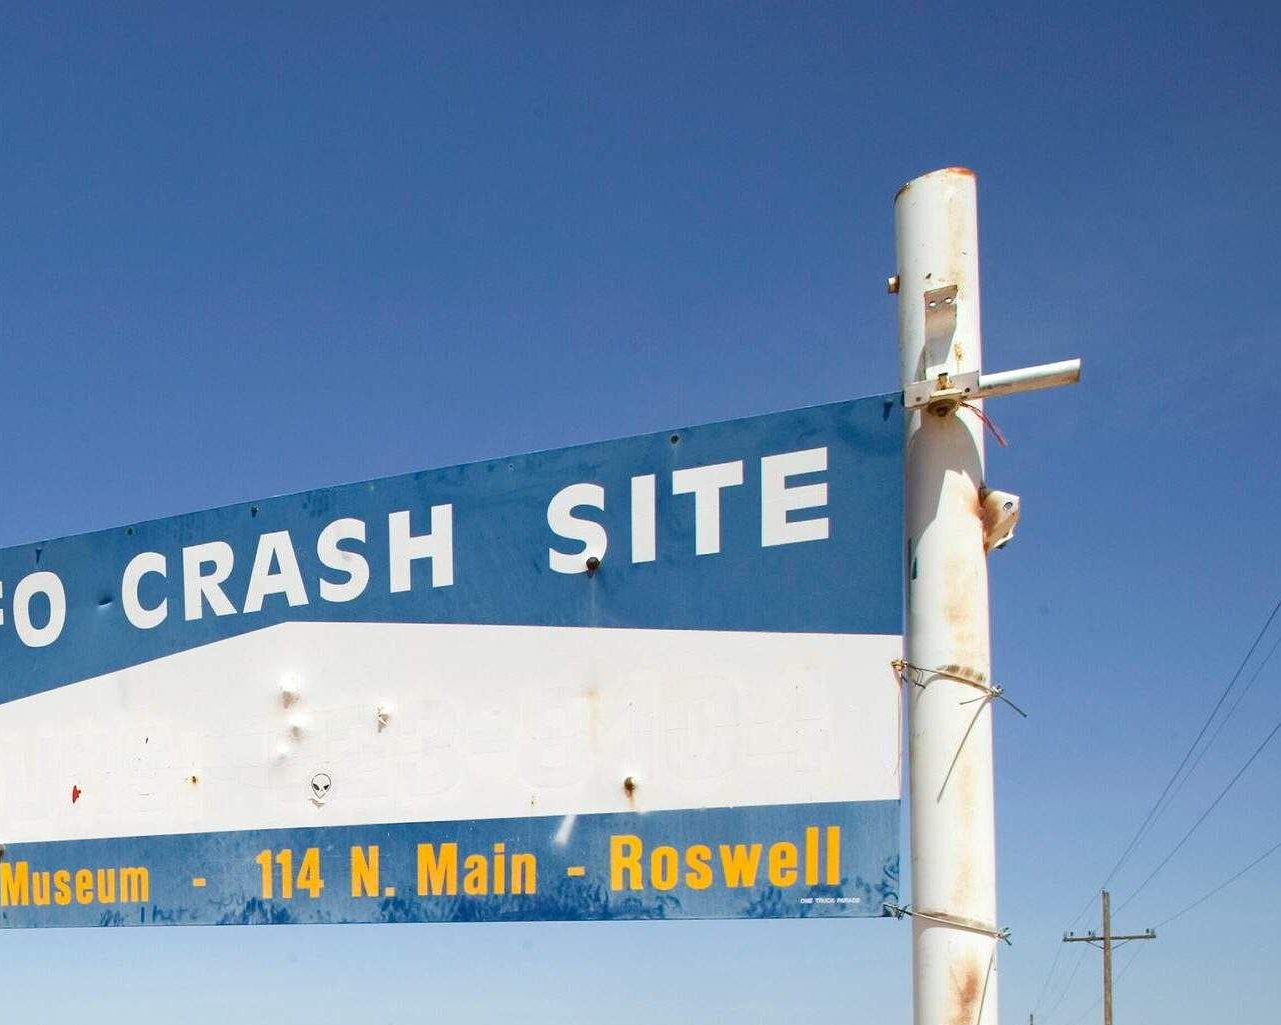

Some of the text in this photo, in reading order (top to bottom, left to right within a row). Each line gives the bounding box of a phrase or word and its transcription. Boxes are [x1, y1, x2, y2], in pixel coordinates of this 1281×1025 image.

[121, 503, 455, 630] CRASH
[547, 446, 829, 575] SITE
[255, 847, 324, 899] 114
[350, 846, 397, 898] N.
[416, 842, 537, 897] Main
[609, 825, 841, 891] Roswell
